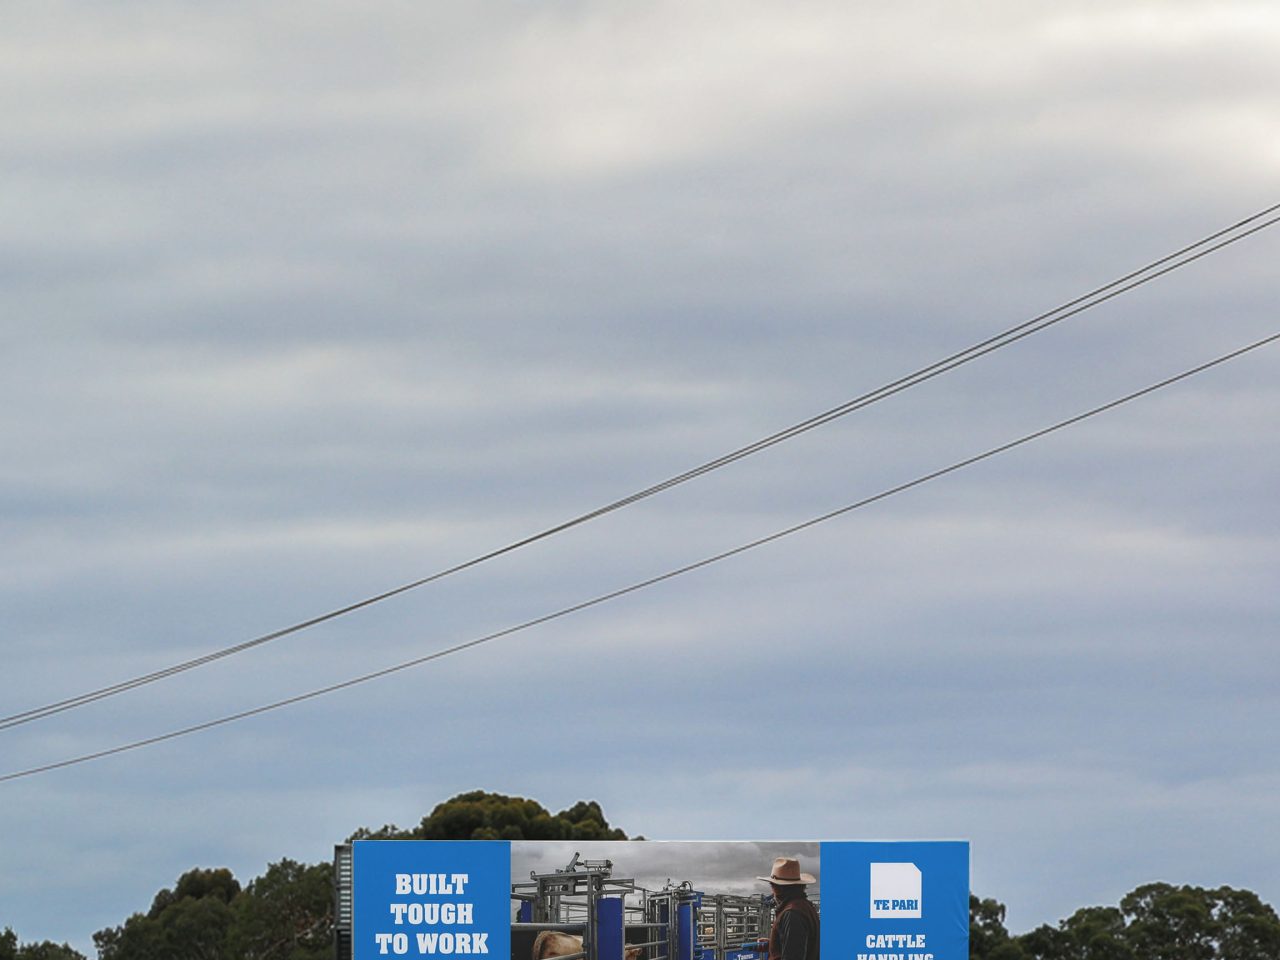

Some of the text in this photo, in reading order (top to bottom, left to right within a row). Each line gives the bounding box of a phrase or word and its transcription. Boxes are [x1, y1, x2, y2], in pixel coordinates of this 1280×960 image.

[395, 873, 469, 895] BUILT
[390, 903, 474, 925] TOUGH
[873, 899, 919, 911] TE PARI
[375, 932, 489, 955] TO WORK
[865, 934, 926, 949] CATTLE
